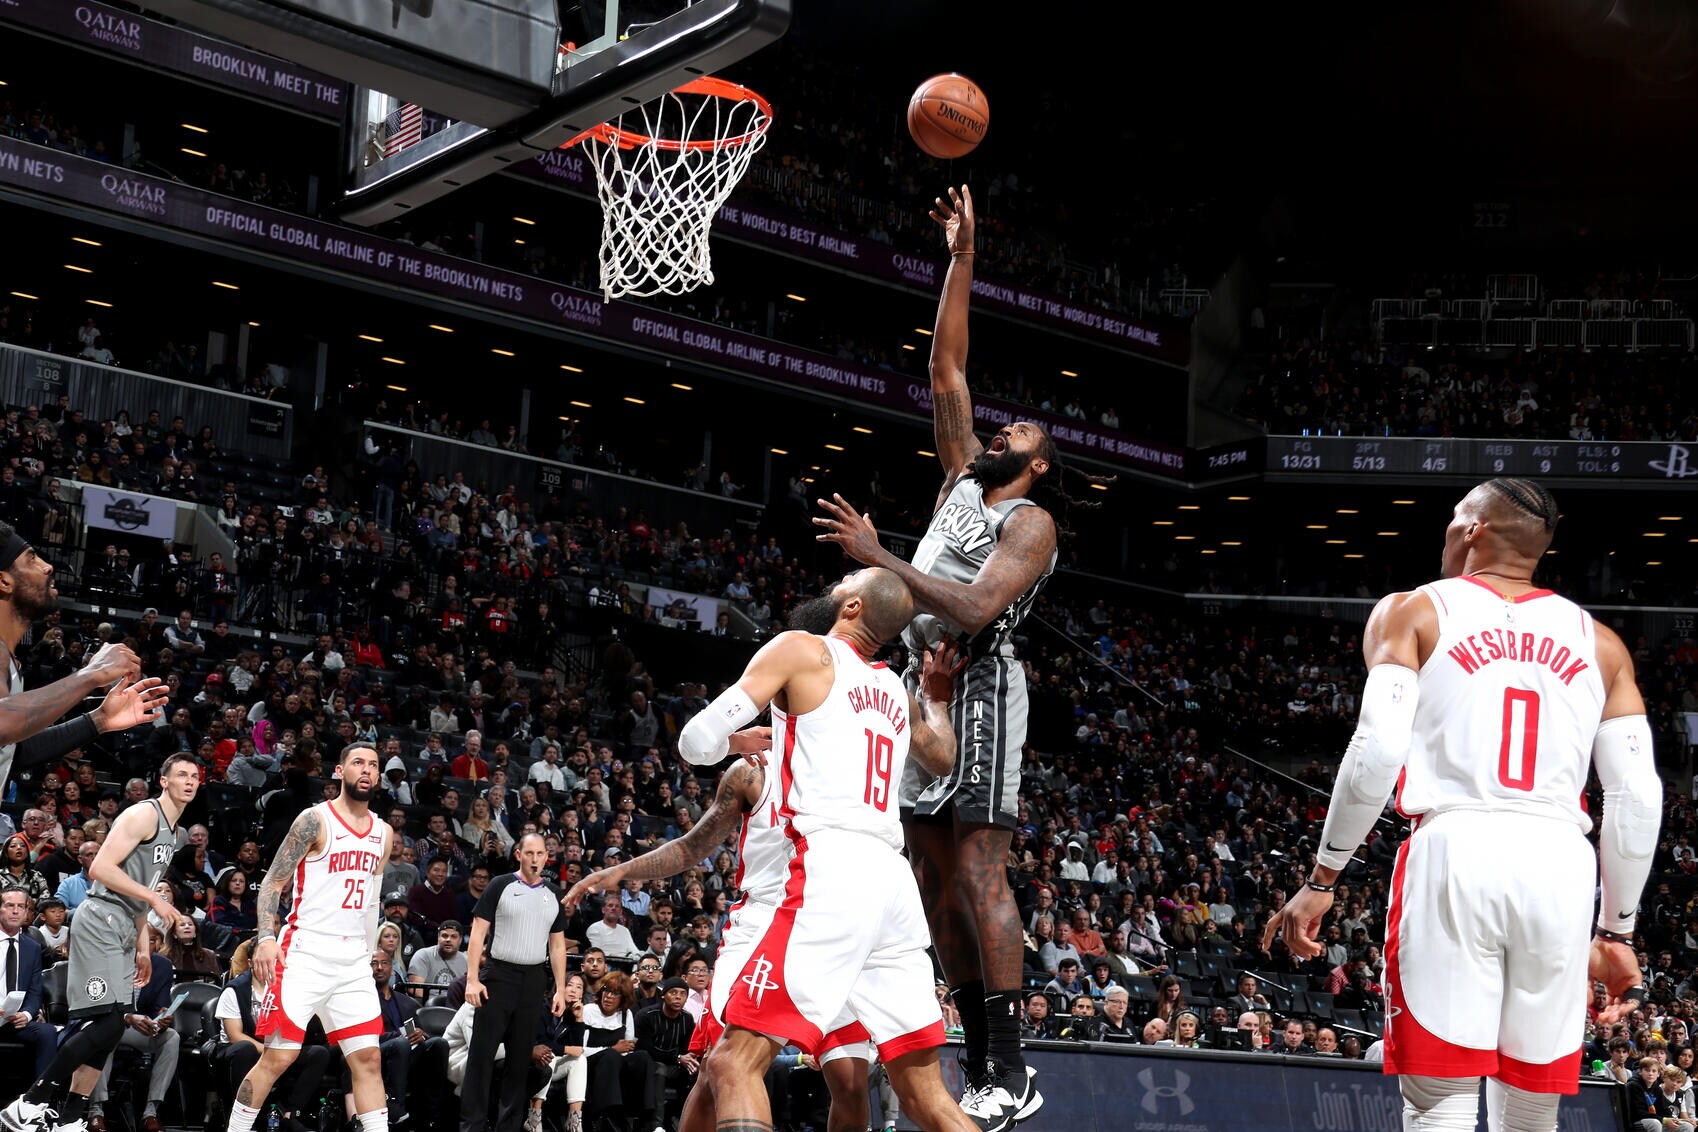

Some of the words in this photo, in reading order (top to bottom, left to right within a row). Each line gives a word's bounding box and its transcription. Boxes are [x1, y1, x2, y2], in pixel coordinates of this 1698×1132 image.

[75, 6, 141, 39] QATAR
[90, 28, 141, 50] AIRWAYS
[193, 46, 270, 85] BROOKLYN,
[273, 70, 311, 95] MEET
[314, 83, 341, 104] THE
[937, 101, 985, 136] SPALDING
[23, 157, 64, 183] NETS
[100, 174, 166, 204] QATAR
[116, 195, 166, 216] AIRWAYS
[1473, 213, 1508, 228] 212
[719, 205, 740, 223] THE
[741, 211, 788, 238] WORLD'S
[789, 225, 817, 247] BEST
[818, 235, 860, 259] AIRLINE.
[206, 206, 266, 236] OFFICIAL
[270, 223, 321, 250] GLOBAL
[324, 237, 375, 264] AIRLINE
[377, 251, 395, 269] OF
[397, 255, 422, 276] THE
[424, 263, 490, 294] BROOKLYN
[491, 282, 524, 302] NETS
[892, 253, 935, 277] QATAR
[550, 291, 602, 316] QATAR
[971, 279, 1017, 306] ROOKLYN,
[1018, 293, 1044, 312] MEET
[1044, 301, 1062, 317] THE
[1063, 305, 1102, 329] WORLD'S
[1103, 317, 1127, 336] BEST
[632, 316, 681, 342] OFFICIAL
[682, 329, 724, 353] GLOBAL
[725, 341, 767, 364] AIRLINE
[768, 352, 782, 367] OF
[783, 355, 804, 374] THE
[805, 361, 859, 387] BROOKLYN
[859, 375, 886, 394] NETS
[36, 367, 60, 381] 108
[1051, 424, 1084, 445] AIRLINE
[1085, 432, 1098, 447] OF
[1099, 436, 1116, 452] THE
[1116, 439, 1161, 462] BROOKLYN
[1161, 452, 1184, 470] NETS
[1207, 453, 1230, 468] 7:45
[1231, 450, 1248, 465] PM
[1293, 441, 1312, 452] FG
[1355, 443, 1381, 453] 3PT
[1426, 443, 1442, 454] FT
[1485, 445, 1513, 456] REB
[1532, 445, 1560, 457] AST
[1611, 445, 1621, 457] 0
[543, 472, 561, 485] 109
[1281, 455, 1321, 469] 13/31
[1352, 456, 1386, 470] 5/13
[1422, 457, 1447, 471] 4/5
[1493, 459, 1504, 472] 9
[1540, 459, 1551, 473] 9
[1577, 461, 1608, 473] TOL:
[1674, 619, 1695, 629] 112
[1447, 628, 1589, 687] WESTBROOK
[847, 685, 907, 736] CHANDLER
[970, 700, 983, 784] NETS
[1498, 686, 1540, 792] 0
[863, 727, 894, 813] 19
[341, 878, 365, 910] 25
[1312, 1081, 1355, 1132] Join
